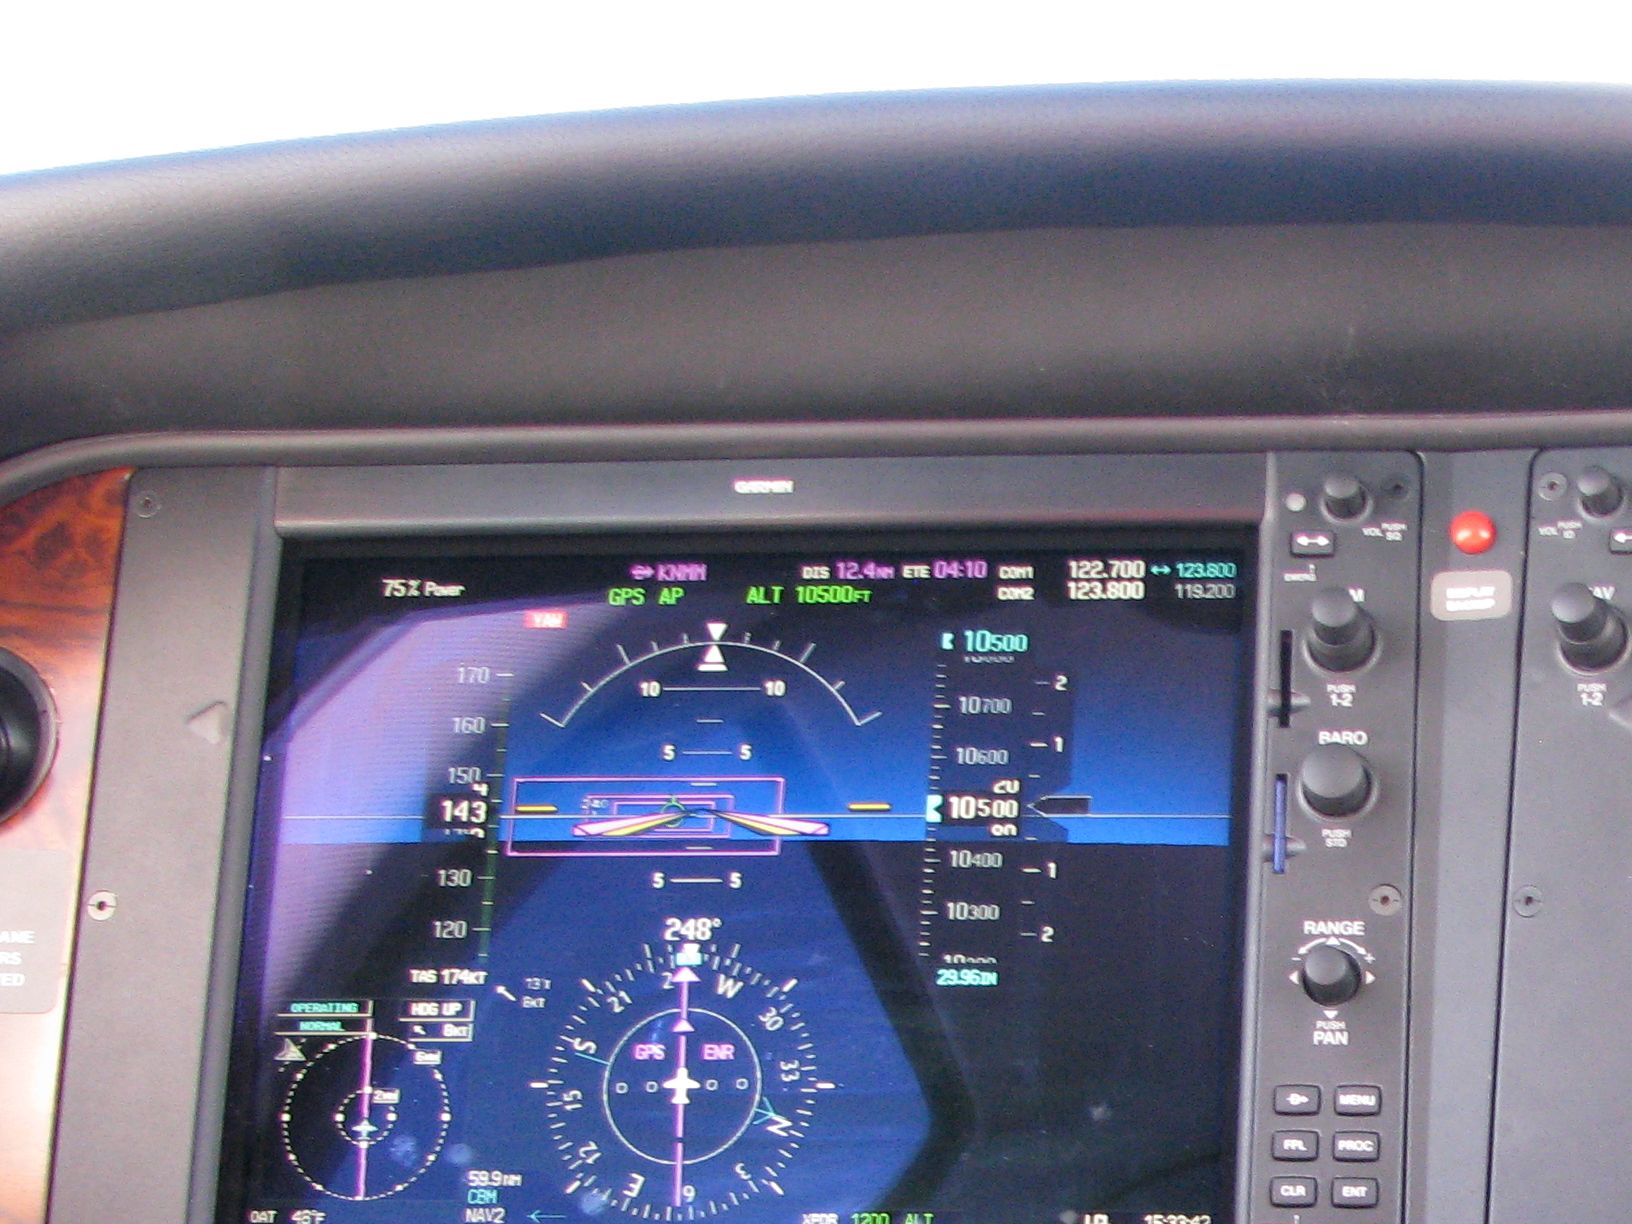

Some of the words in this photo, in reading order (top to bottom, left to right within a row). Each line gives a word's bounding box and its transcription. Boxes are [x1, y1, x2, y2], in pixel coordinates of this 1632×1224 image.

[904, 565, 930, 578] ETE
[934, 561, 988, 578] 04:10
[1069, 561, 1145, 579] 122.700
[382, 579, 420, 597] 75%
[609, 587, 644, 606] GPS
[659, 587, 684, 605] AP
[748, 587, 783, 604] ALT
[458, 667, 490, 683] 170
[453, 717, 485, 734] 160
[1319, 731, 1367, 744] BARO
[441, 799, 486, 823] 143
[438, 870, 471, 886] 130
[434, 921, 466, 938] 120
[1304, 921, 1364, 935] RANGE
[1313, 1031, 1348, 1045] PAN
[635, 1045, 664, 1060] GPS
[704, 1045, 734, 1060] ENR
[1339, 1094, 1376, 1105] MENU
[1339, 1140, 1373, 1152] PROC
[1281, 1186, 1305, 1196] CLR
[1343, 1186, 1367, 1197] ENT
